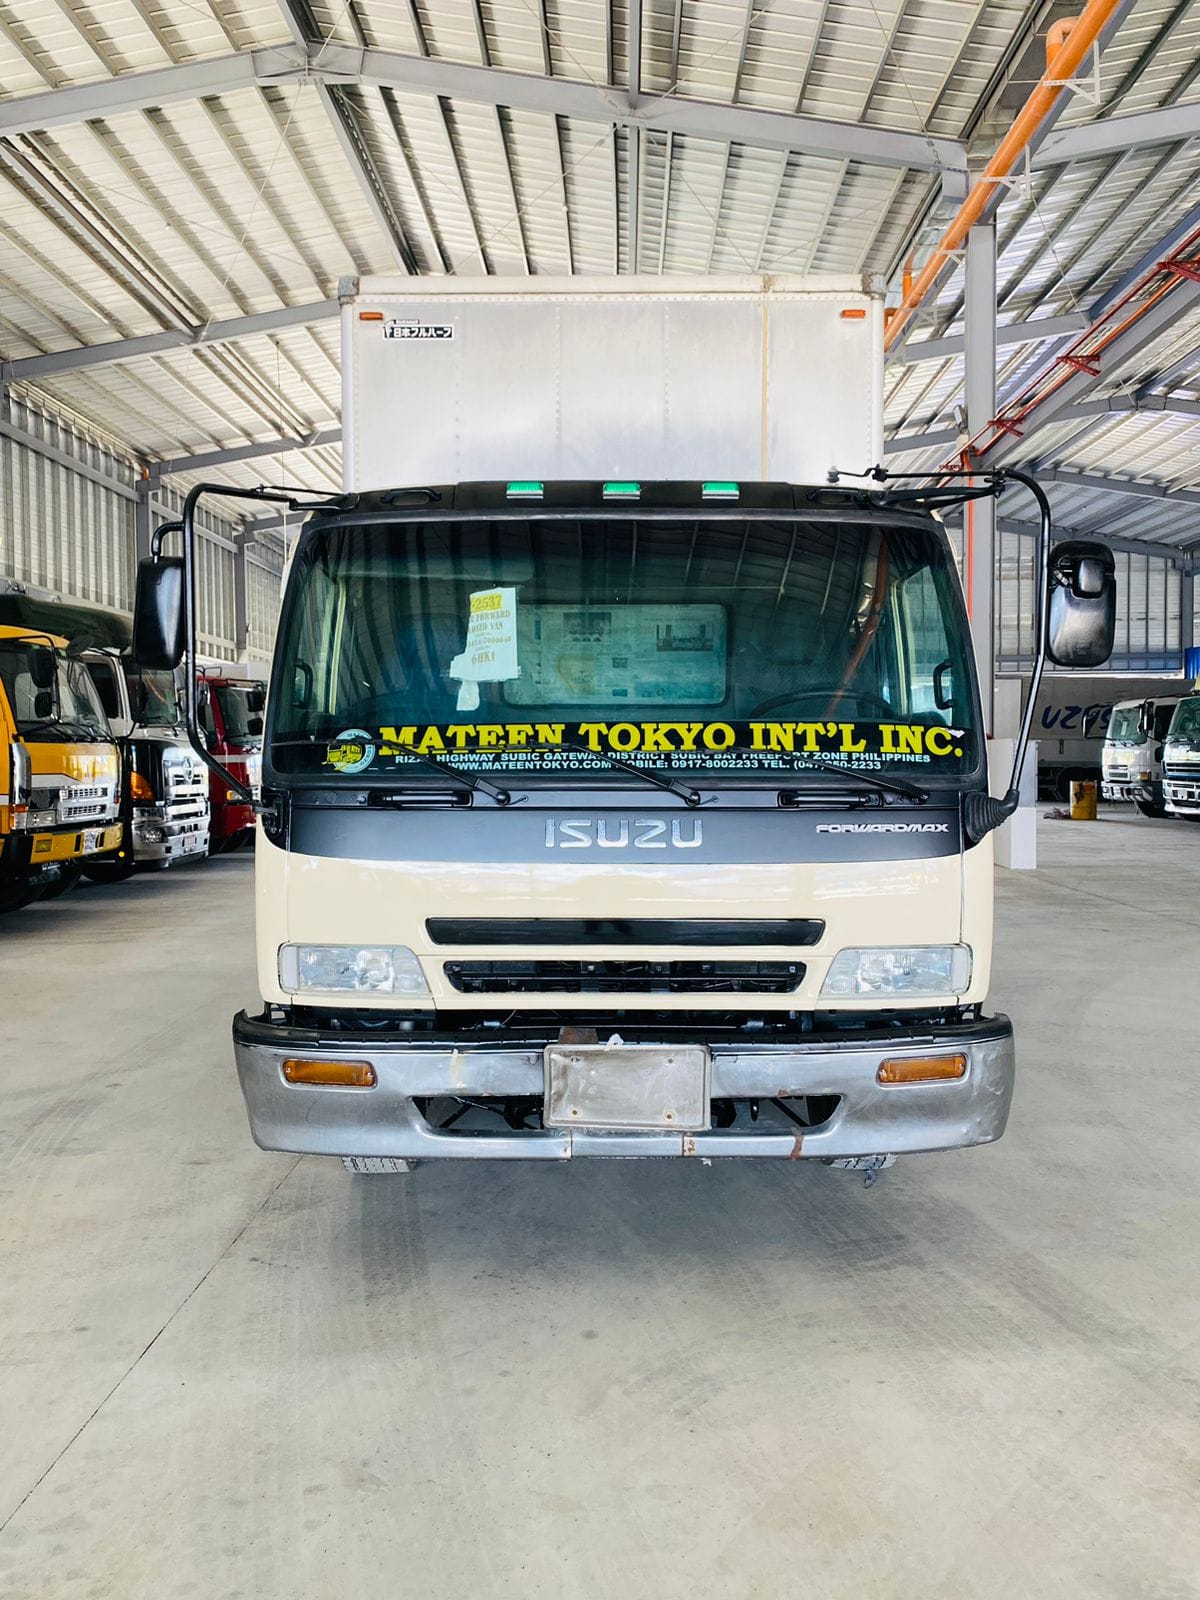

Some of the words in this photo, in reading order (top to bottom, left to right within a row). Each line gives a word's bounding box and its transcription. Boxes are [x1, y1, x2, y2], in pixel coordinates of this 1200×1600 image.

[394, 327, 451, 338] 日本フルハーフ
[378, 724, 566, 756] MATEEN
[578, 722, 736, 752] TOKYO
[749, 722, 867, 752] INT'L
[879, 724, 963, 757] INC.
[395, 755, 430, 763] RIZ
[436, 753, 496, 762] HIGHWAY
[501, 752, 540, 761] SUBIC
[544, 751, 603, 760] GATEWA
[670, 751, 710, 760] SUBIC
[714, 752, 737, 760] BAY
[813, 752, 848, 760] ZONE
[852, 752, 931, 763] PHILIPPINES
[615, 760, 668, 768] BILE:
[672, 760, 758, 768] 0917-8002233
[762, 760, 790, 768] TEL.
[545, 819, 703, 848] ISUZU
